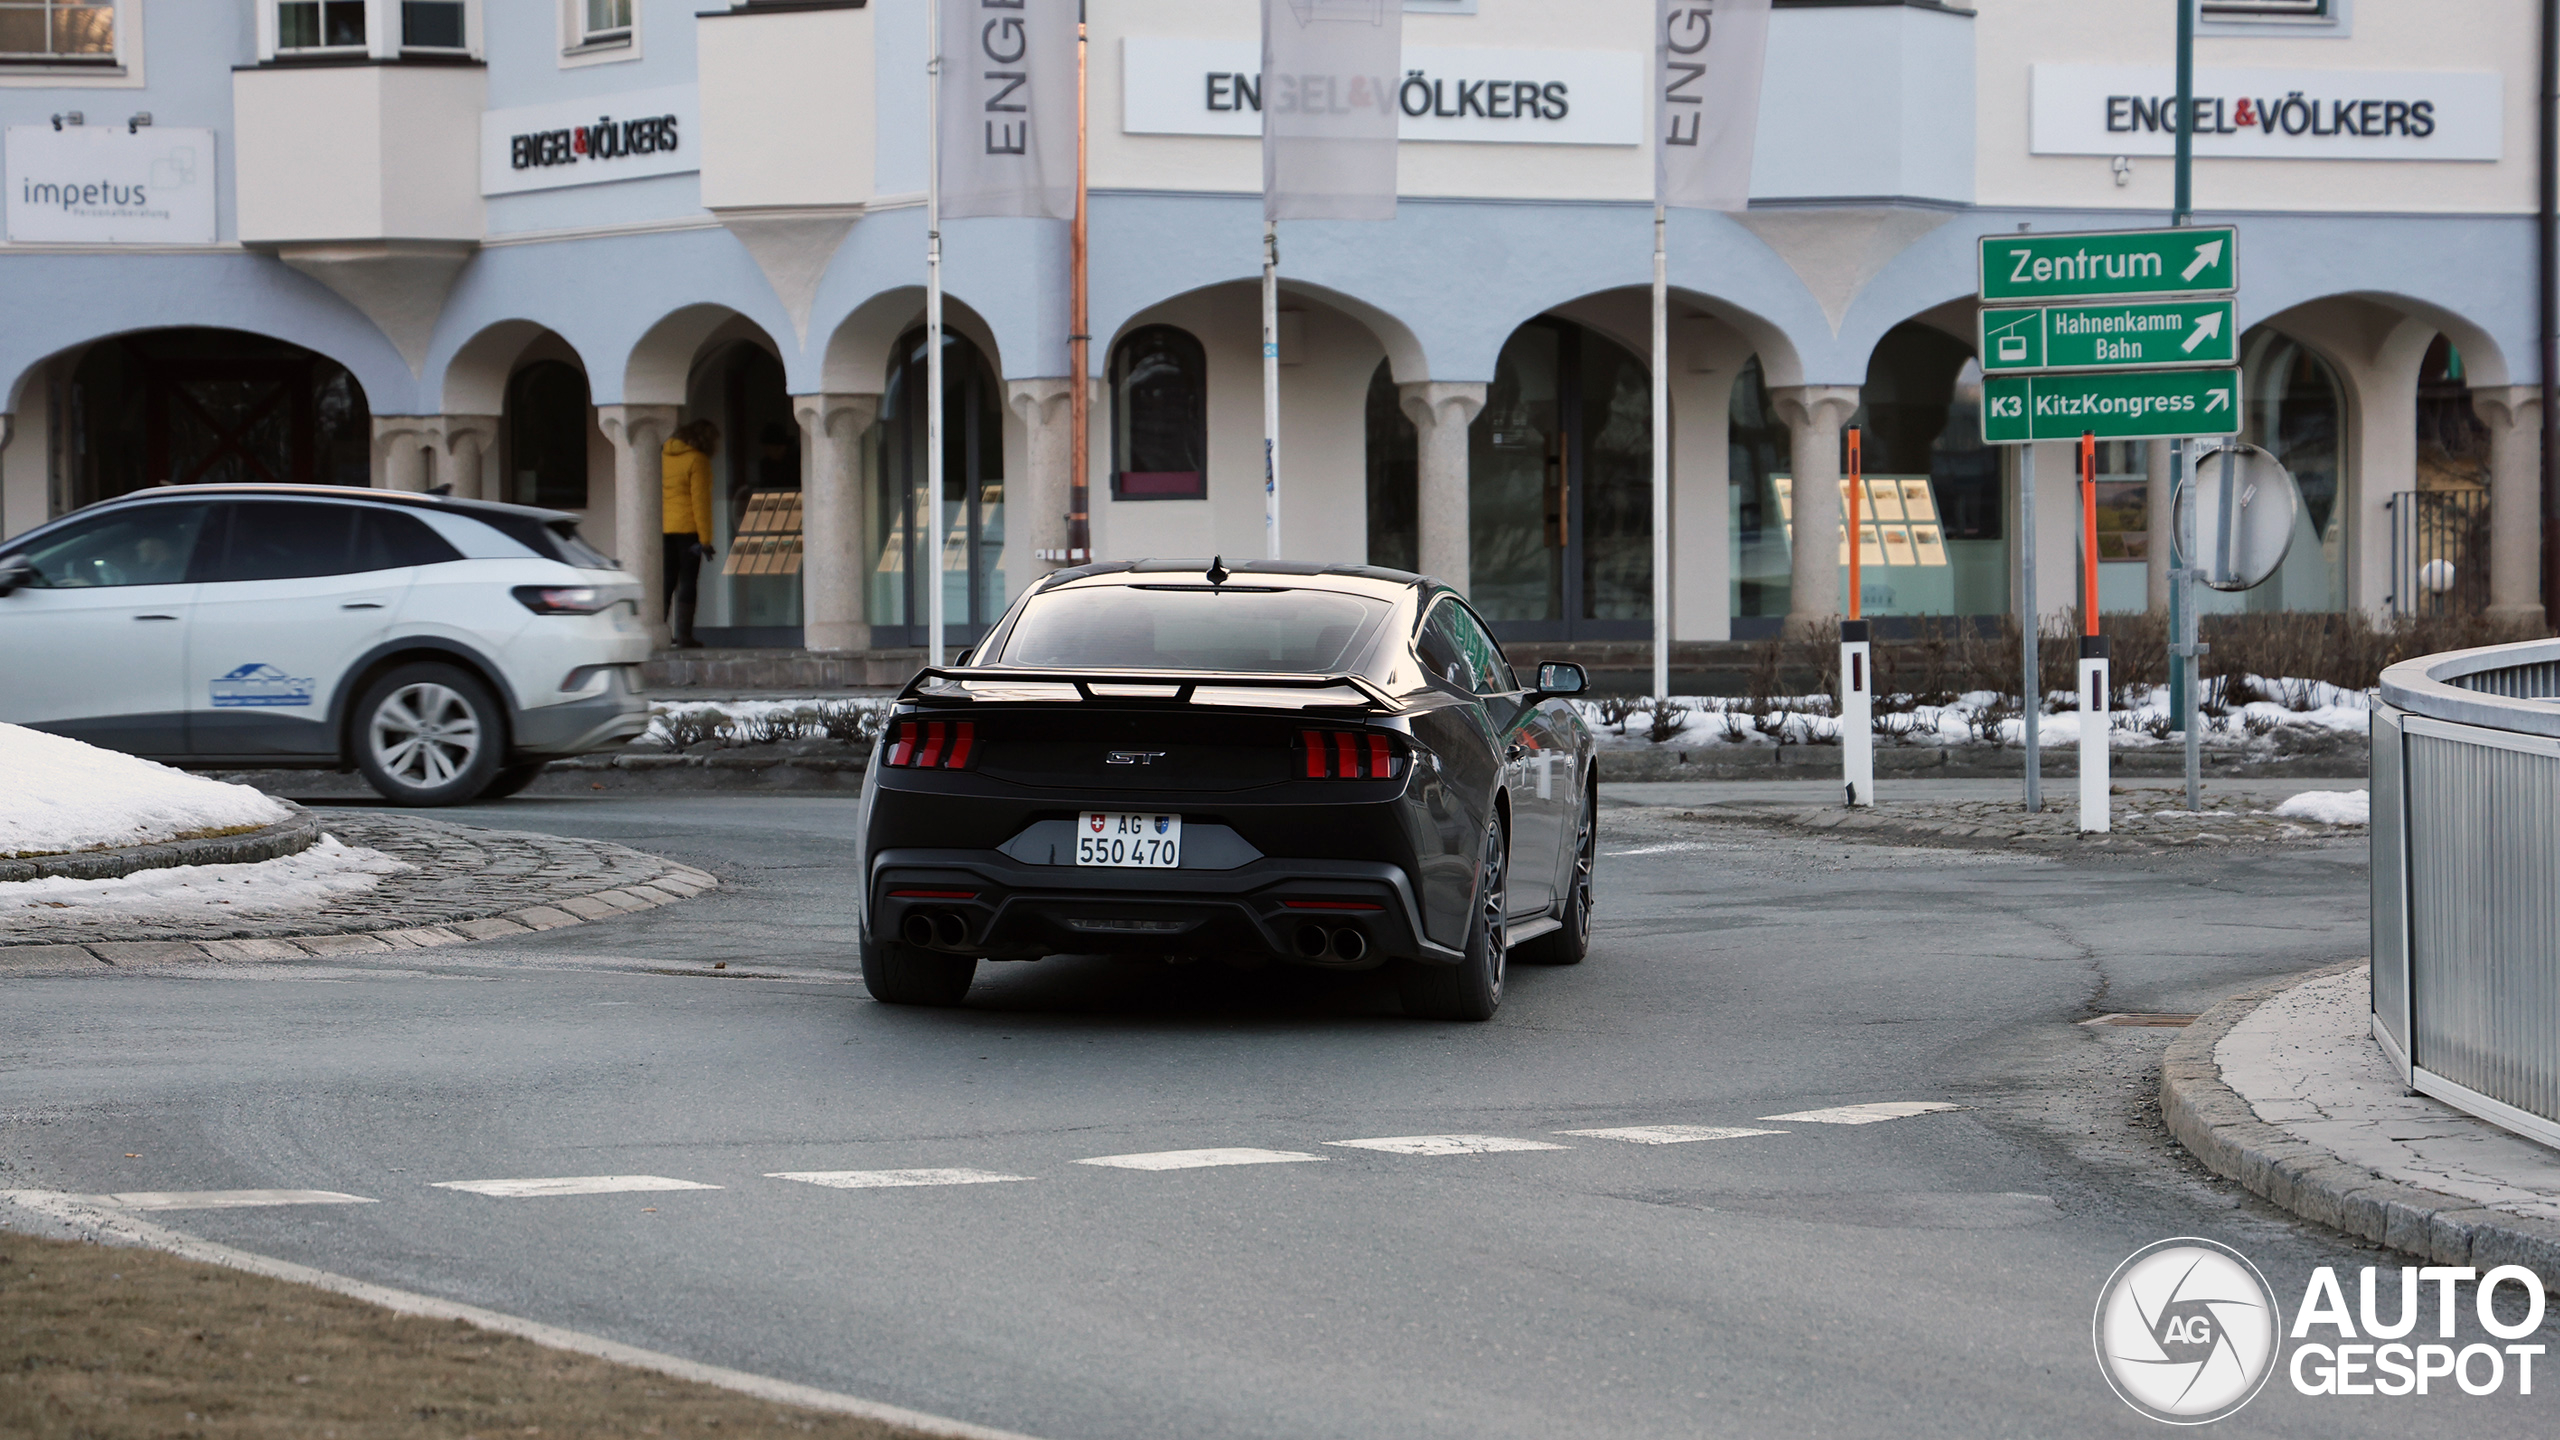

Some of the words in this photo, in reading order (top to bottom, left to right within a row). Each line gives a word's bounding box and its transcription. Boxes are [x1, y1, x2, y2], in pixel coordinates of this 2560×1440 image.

[981, 0, 1027, 155] ENG
[511, 114, 678, 169] ENGEL&VÖLKERS
[24, 177, 146, 211] impetus
[2009, 247, 2162, 282] Zentrum
[2055, 310, 2183, 335] Hahnenkamm
[2096, 338, 2143, 360] Bahn
[1991, 395, 2023, 417] K3
[2036, 393, 2196, 418] KitzKongress
[1105, 751, 1167, 765] GT
[1117, 815, 1142, 834] AG
[1080, 838, 1125, 864] 550
[1131, 839, 1176, 865] 470
